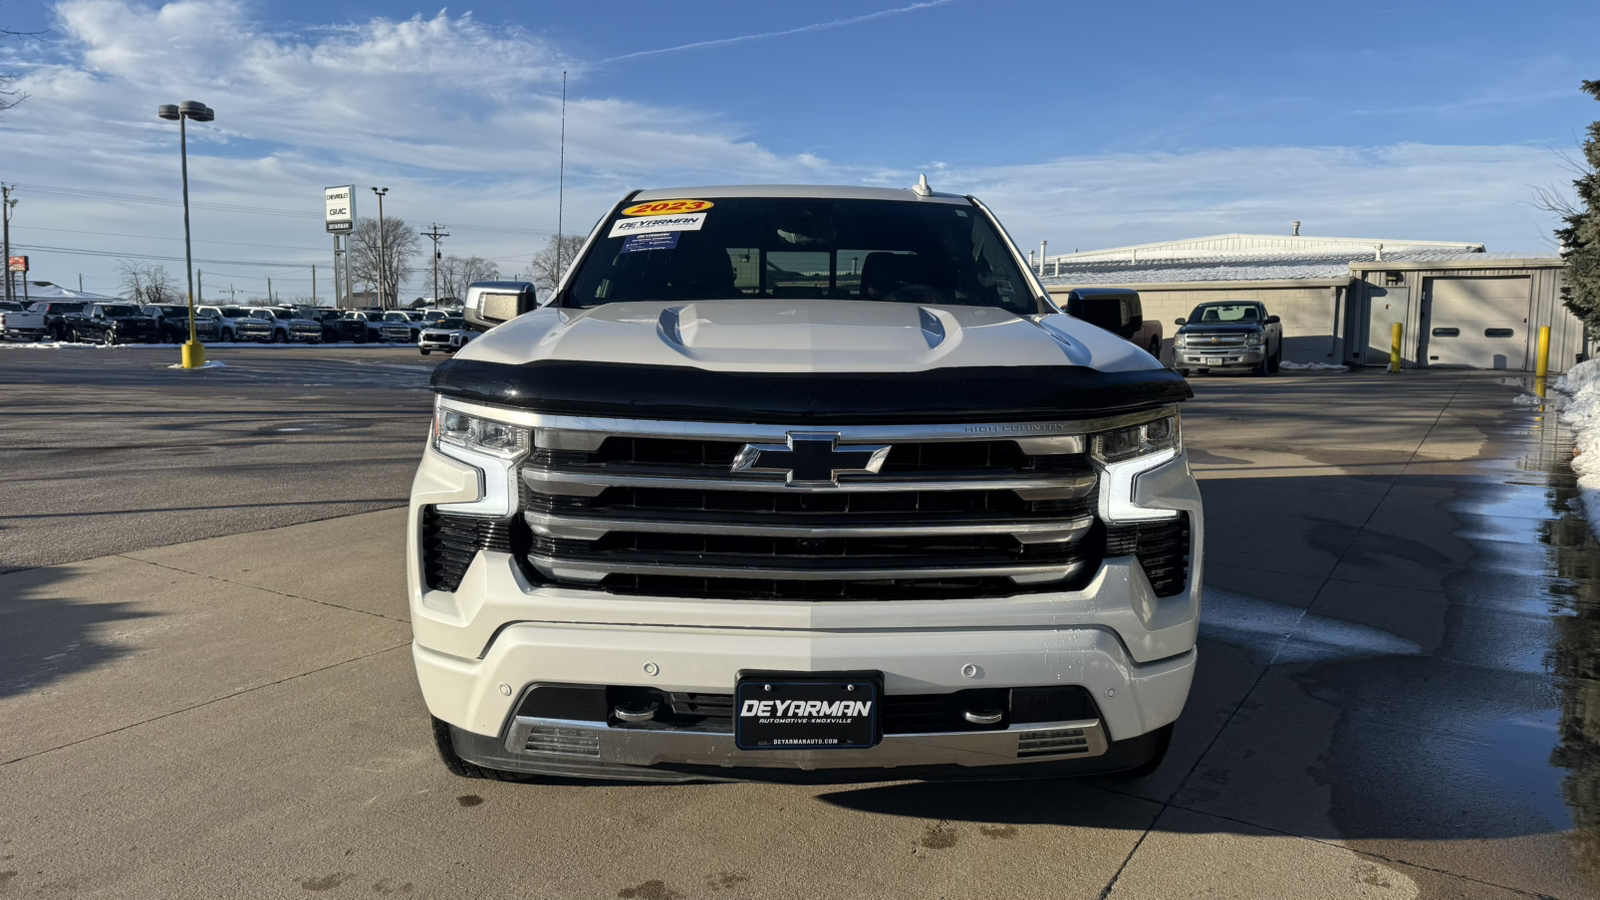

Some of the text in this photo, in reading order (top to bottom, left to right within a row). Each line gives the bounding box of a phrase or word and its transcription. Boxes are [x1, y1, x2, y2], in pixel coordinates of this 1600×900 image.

[634, 201, 704, 214] 2023
[618, 217, 699, 229] DEYARMAN
[1002, 423, 1066, 432] COUNTRY
[740, 699, 873, 717] DEYARMAN
